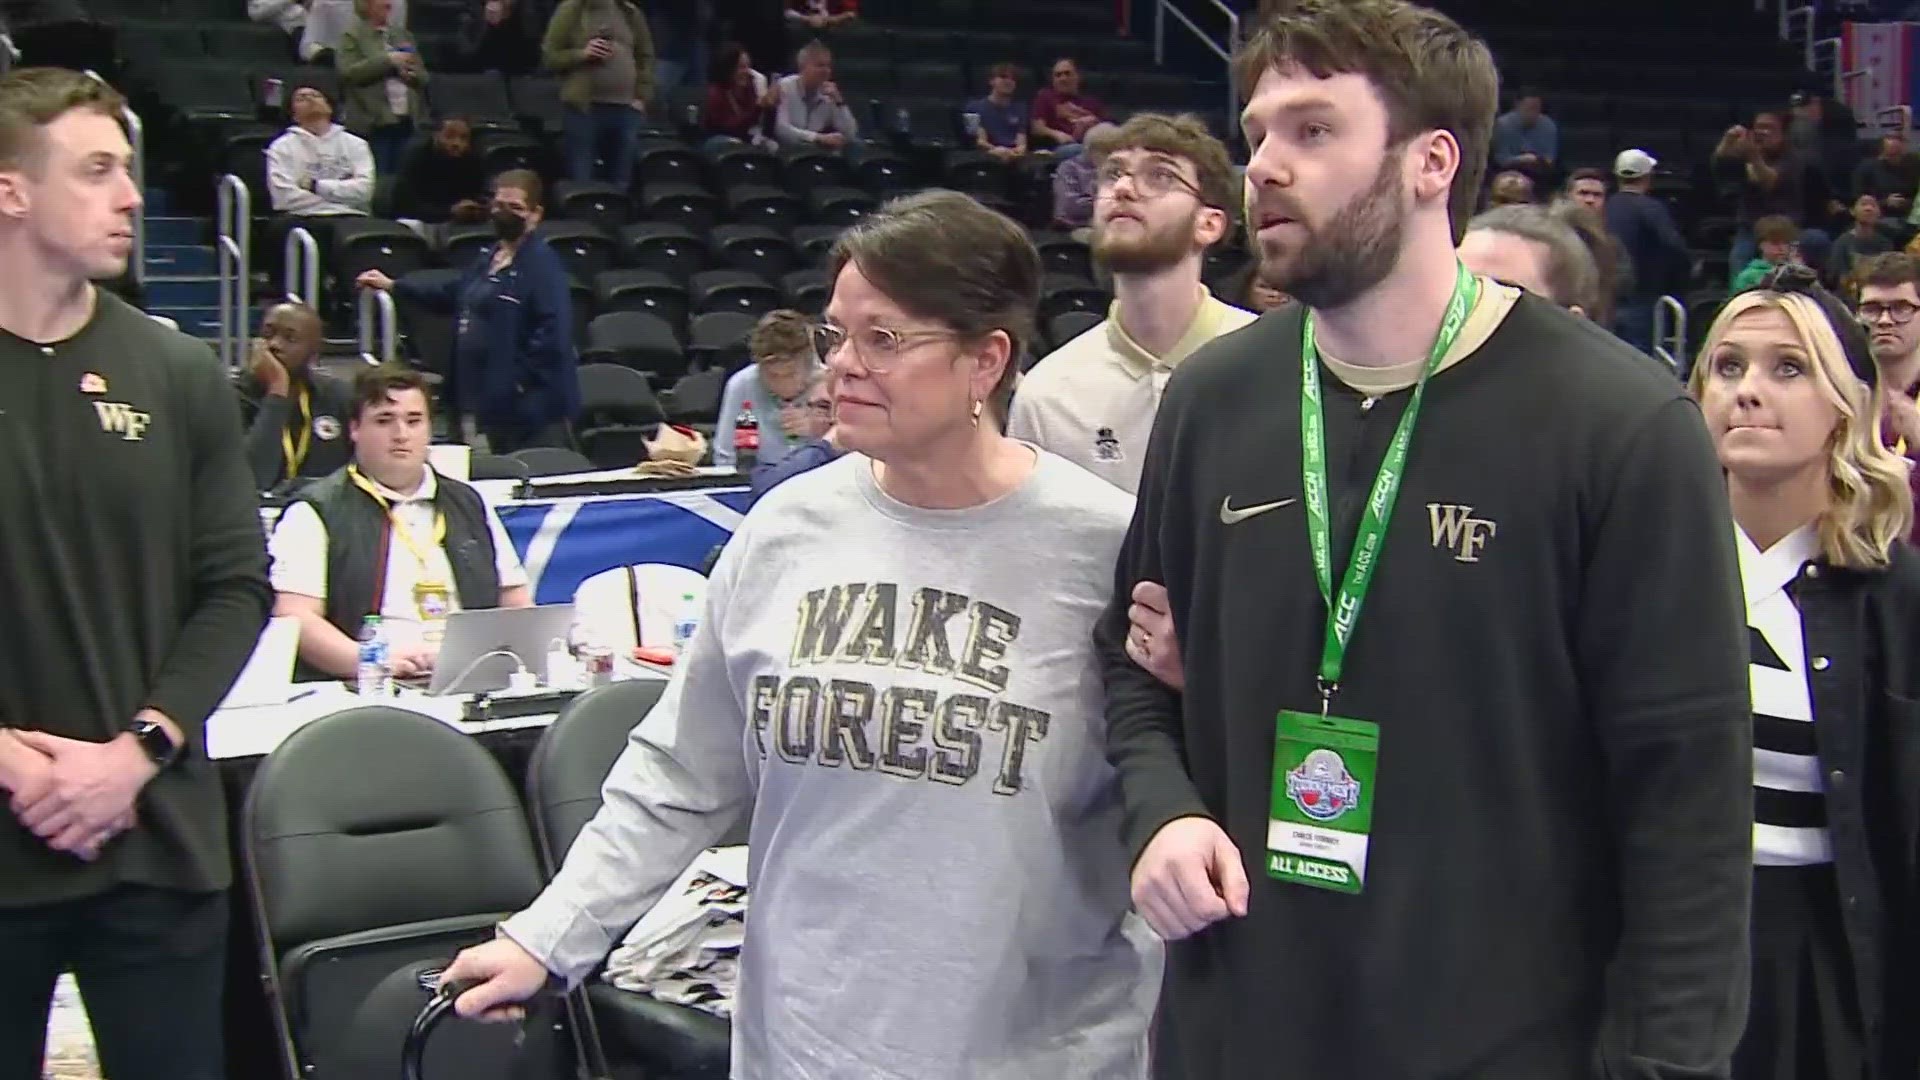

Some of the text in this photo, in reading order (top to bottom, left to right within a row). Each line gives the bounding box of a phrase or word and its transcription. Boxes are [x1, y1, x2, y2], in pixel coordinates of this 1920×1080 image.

[1303, 358, 1318, 403] ACC
[92, 401, 151, 441] WF
[1305, 471, 1325, 524] ACCN
[1370, 467, 1395, 522] ACCN
[1426, 503, 1496, 562] WF
[789, 582, 1022, 693] WAKE
[1334, 591, 1357, 651] ACC
[753, 674, 1052, 797] FOREST
[1270, 854, 1350, 884] ALL ACCESS
